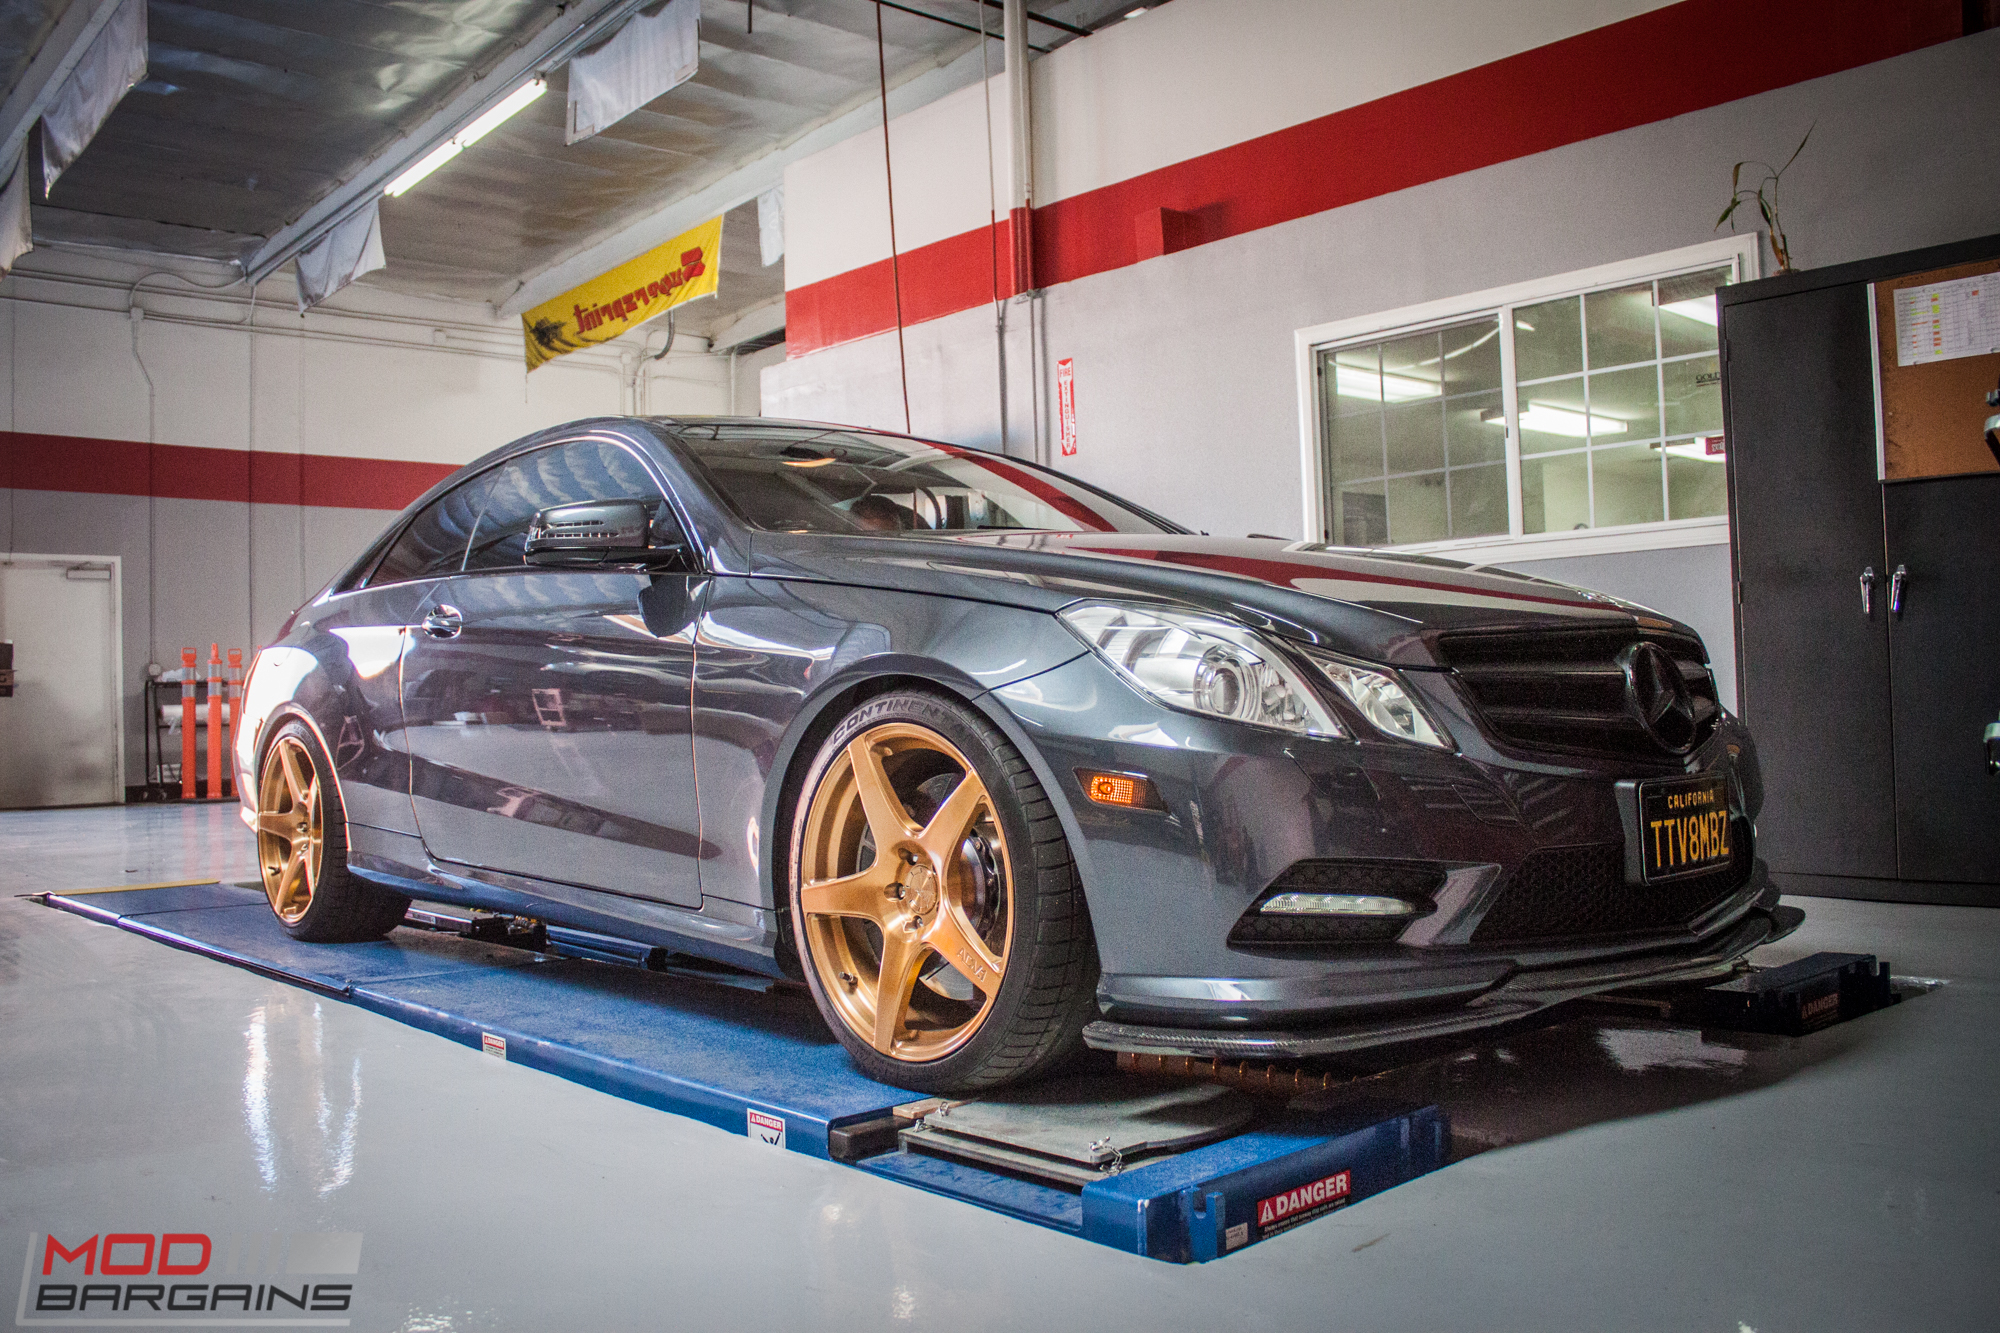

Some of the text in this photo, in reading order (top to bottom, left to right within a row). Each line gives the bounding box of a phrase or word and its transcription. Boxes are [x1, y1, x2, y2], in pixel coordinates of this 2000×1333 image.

[1060, 367, 1071, 378] FIRE
[1667, 789, 1714, 809] CALIFORNIA
[1650, 811, 1729, 868] TTV8MBZ
[756, 1115, 782, 1130] DANGER
[1276, 1173, 1348, 1217] DANGER
